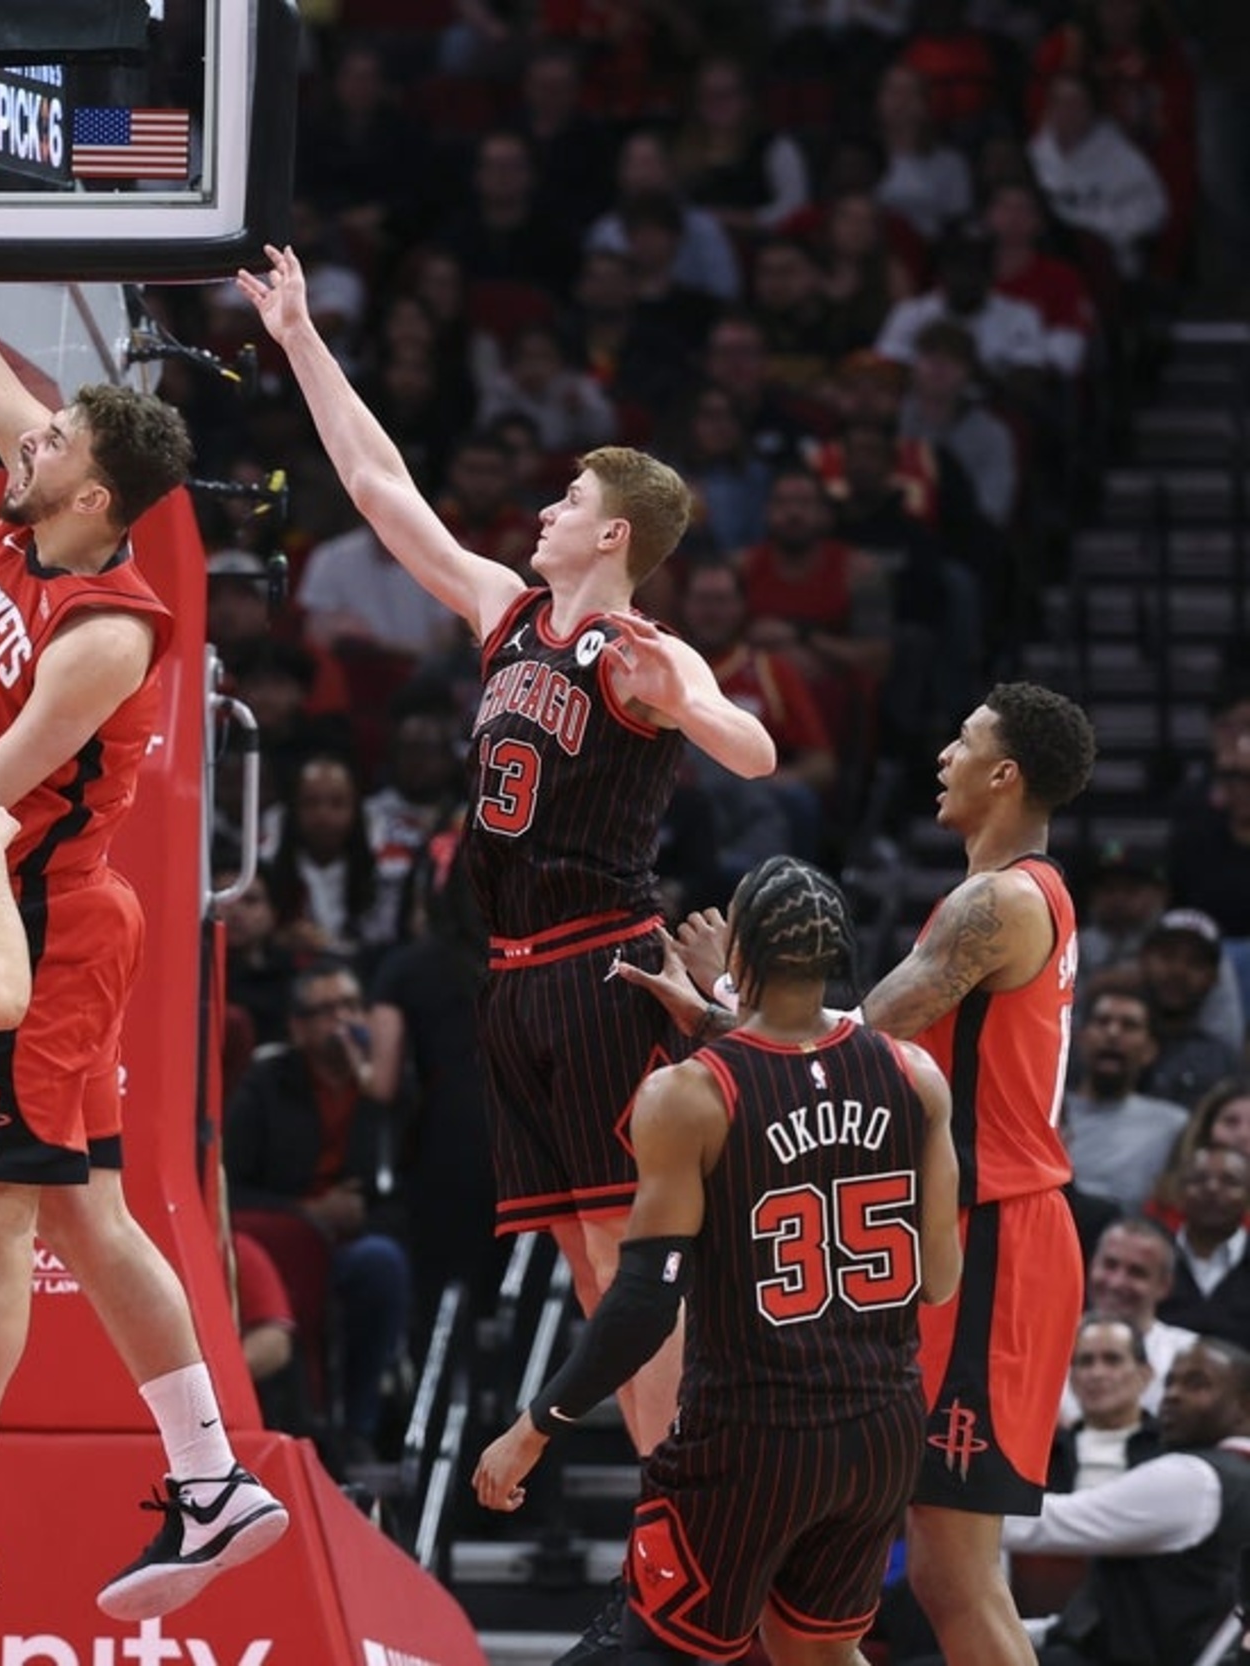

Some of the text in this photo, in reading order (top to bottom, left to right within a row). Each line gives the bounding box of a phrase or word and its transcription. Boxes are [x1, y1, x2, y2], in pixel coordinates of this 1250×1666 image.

[472, 660, 591, 757] CHICAGO
[765, 1099, 892, 1165] OKORO
[751, 1169, 922, 1327] 35
